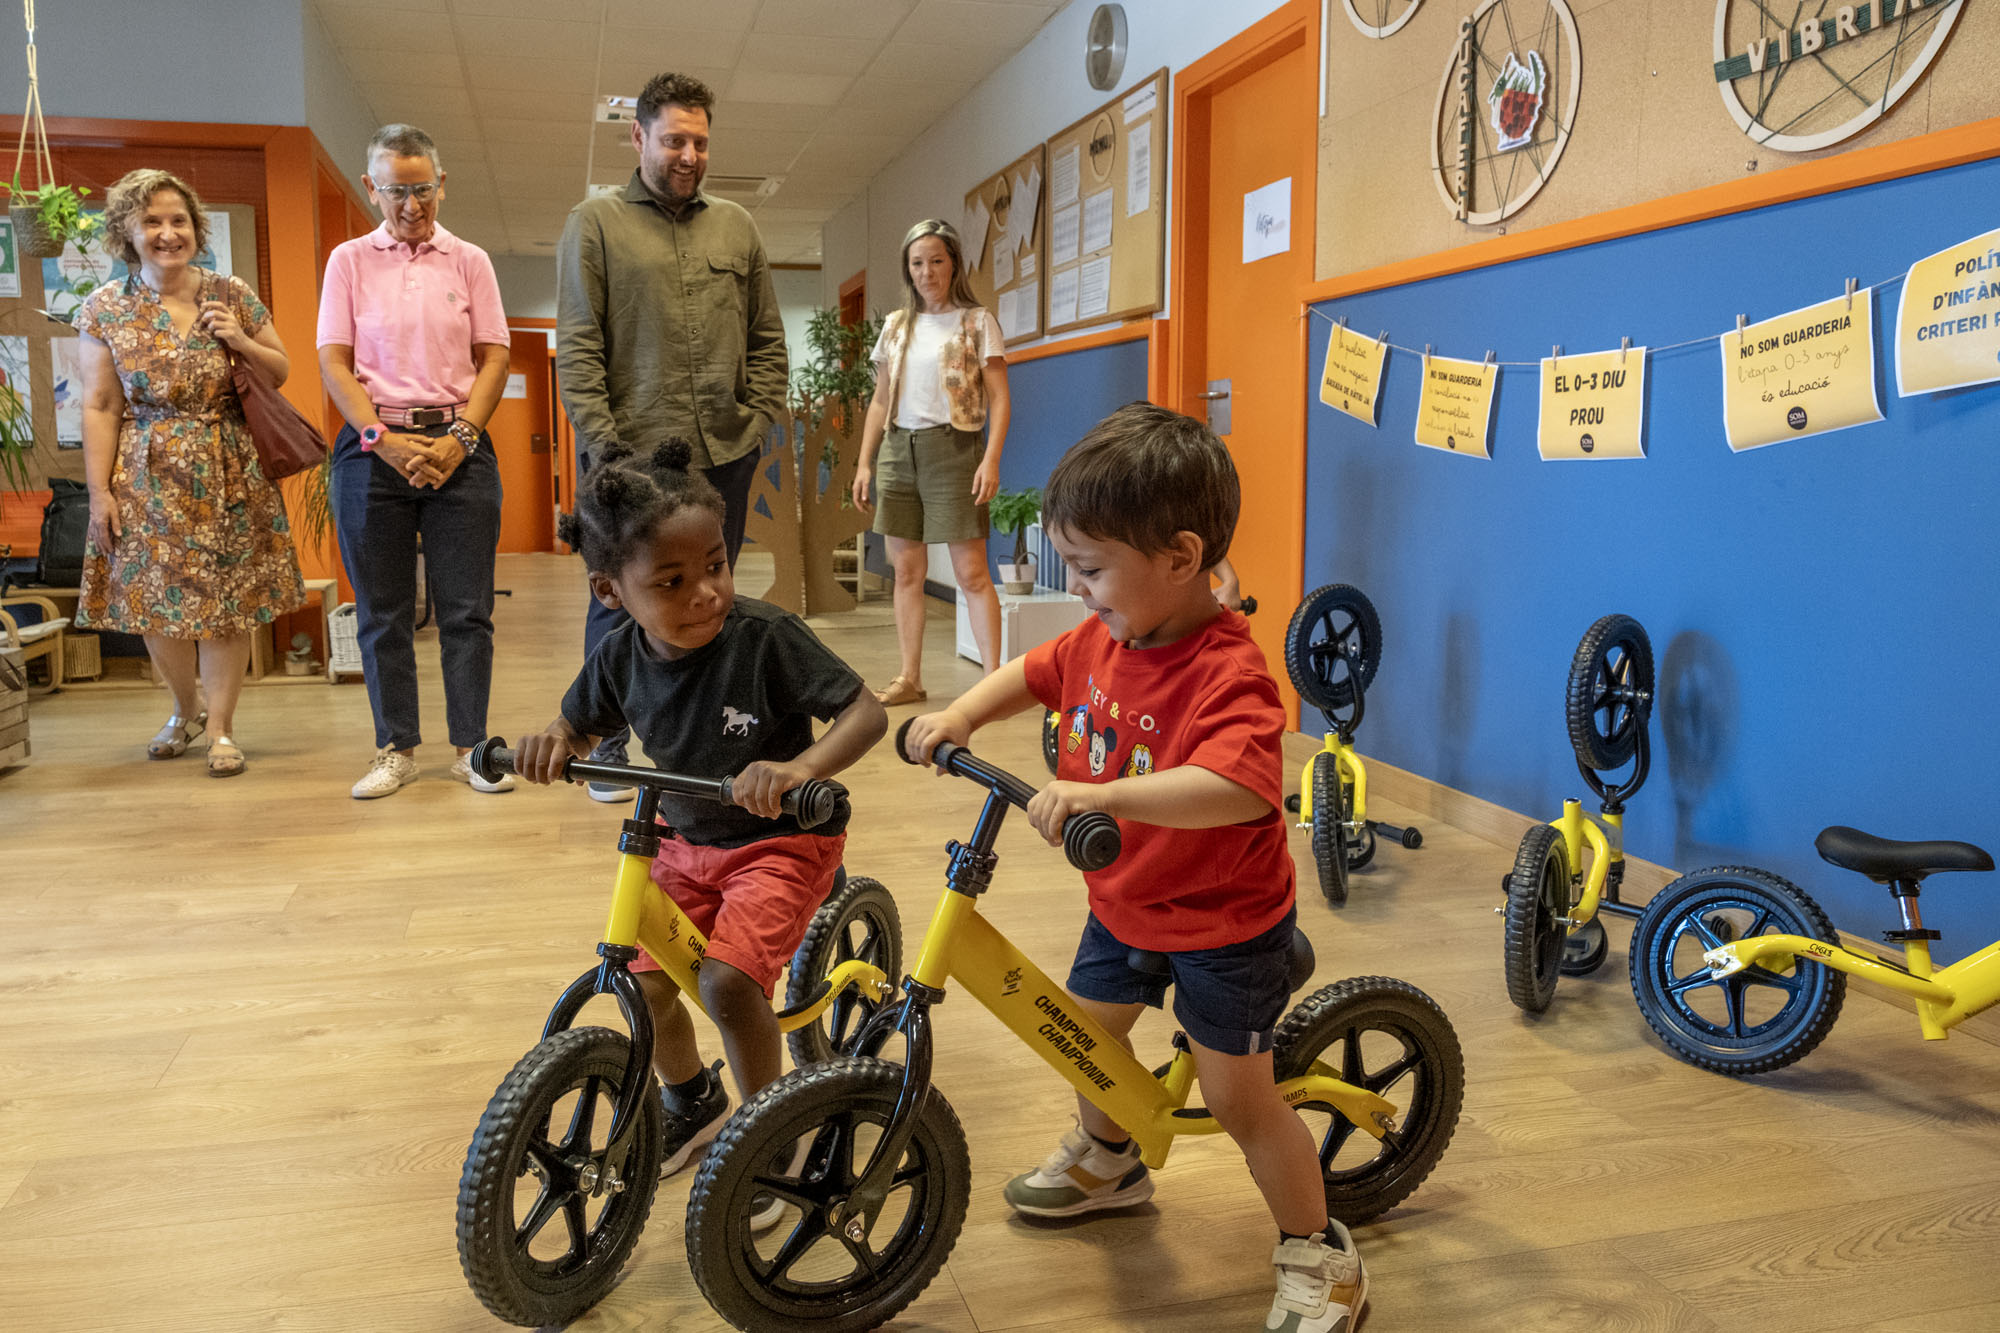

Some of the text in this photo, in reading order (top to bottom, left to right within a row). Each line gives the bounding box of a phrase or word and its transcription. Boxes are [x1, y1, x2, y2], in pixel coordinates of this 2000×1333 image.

[1740, 315, 1851, 359] NO SOM GUARDERIA
[1917, 313, 1987, 342] CRITERI
[1784, 349, 1810, 370] 0-3
[1816, 344, 1851, 369] anys
[1430, 370, 1482, 387] NO SOM GUARDERIA
[1555, 369, 1626, 393] EL 0-3 DIU
[1761, 376, 1831, 402] és educació
[1569, 406, 1604, 426] PROU
[1110, 702, 1120, 720] &
[1126, 710, 1161, 734] CO.
